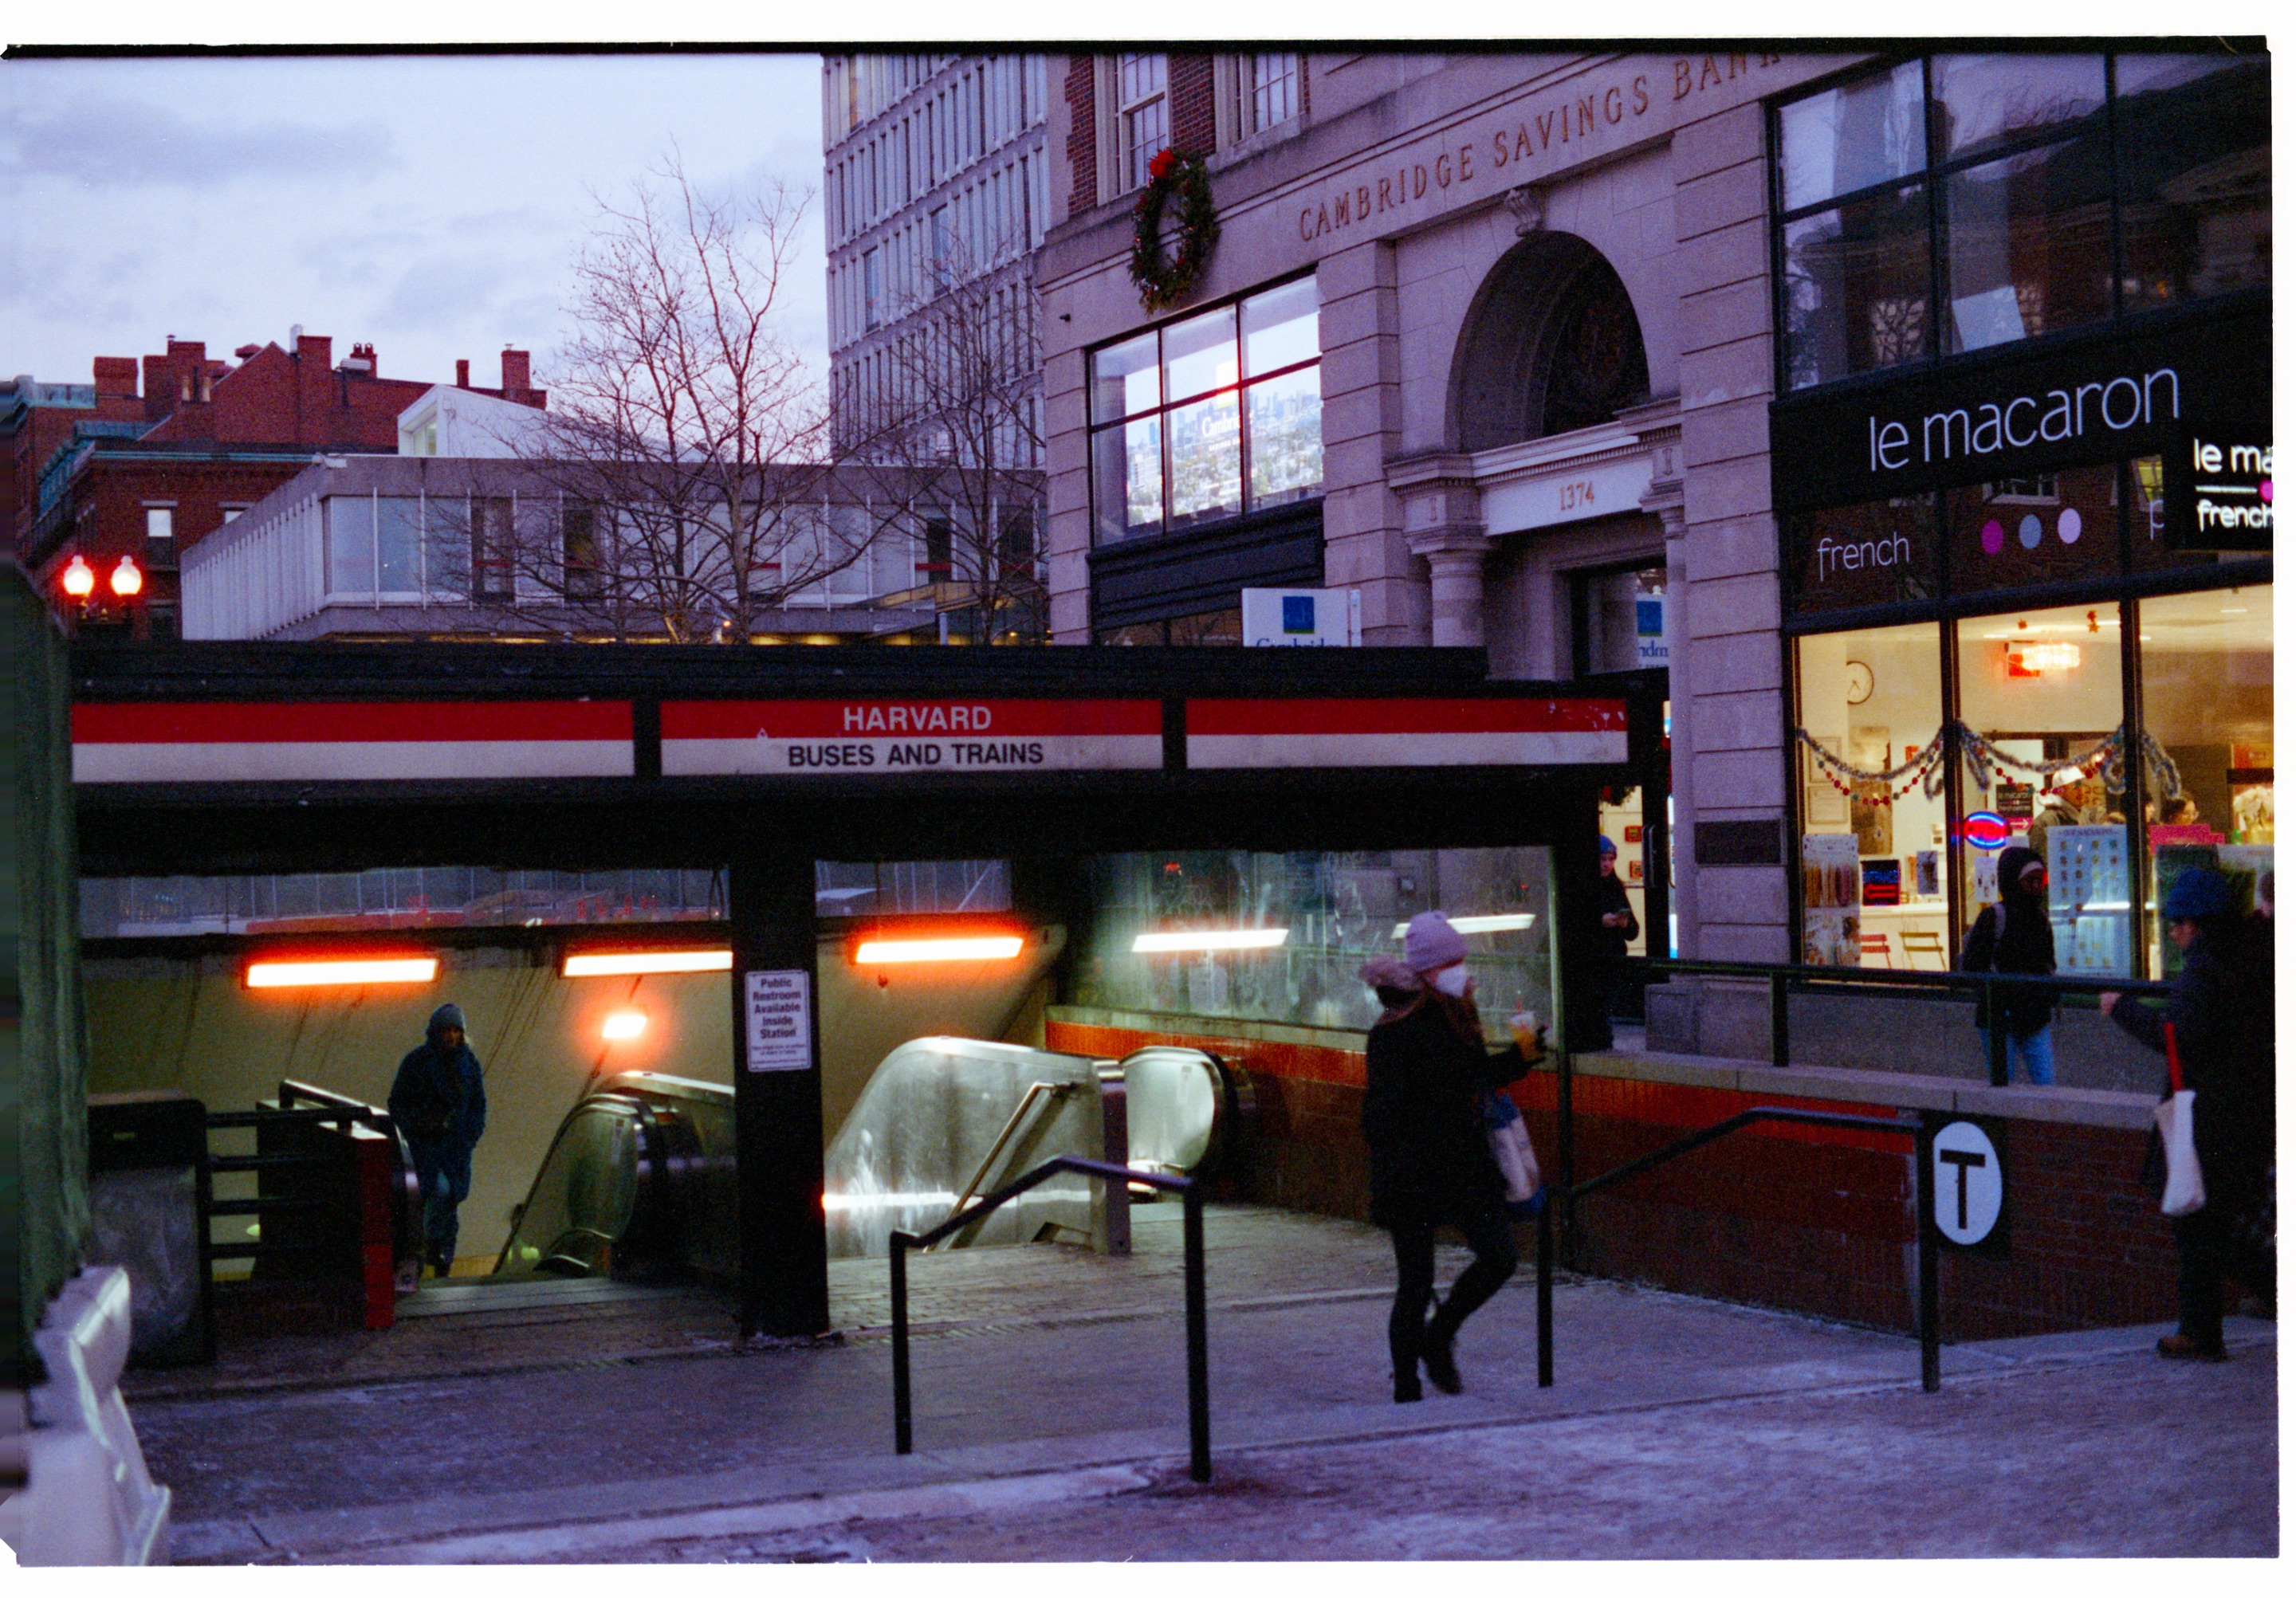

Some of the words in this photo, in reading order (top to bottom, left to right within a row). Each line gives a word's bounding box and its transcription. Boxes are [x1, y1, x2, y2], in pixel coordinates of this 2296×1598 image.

[1298, 142, 1475, 242] CAMBRIDGE
[1492, 73, 1650, 168] SAVINGS
[1201, 409, 1255, 438] Cambri
[1869, 415, 1910, 472] le
[1924, 367, 2180, 462] macaron
[2194, 438, 2223, 473] le
[1559, 481, 1594, 511] 1374
[1817, 532, 1910, 582] french
[843, 706, 992, 732] HARVARD
[788, 744, 875, 767] BUSES
[887, 744, 942, 766] AND
[951, 742, 1044, 765] TRAINS
[753, 991, 802, 1001] Restroom
[761, 978, 792, 988] Public
[754, 1003, 801, 1014] Available
[762, 1015, 794, 1027] Inside
[760, 1028, 796, 1039] Station
[1940, 1148, 1986, 1230] T
